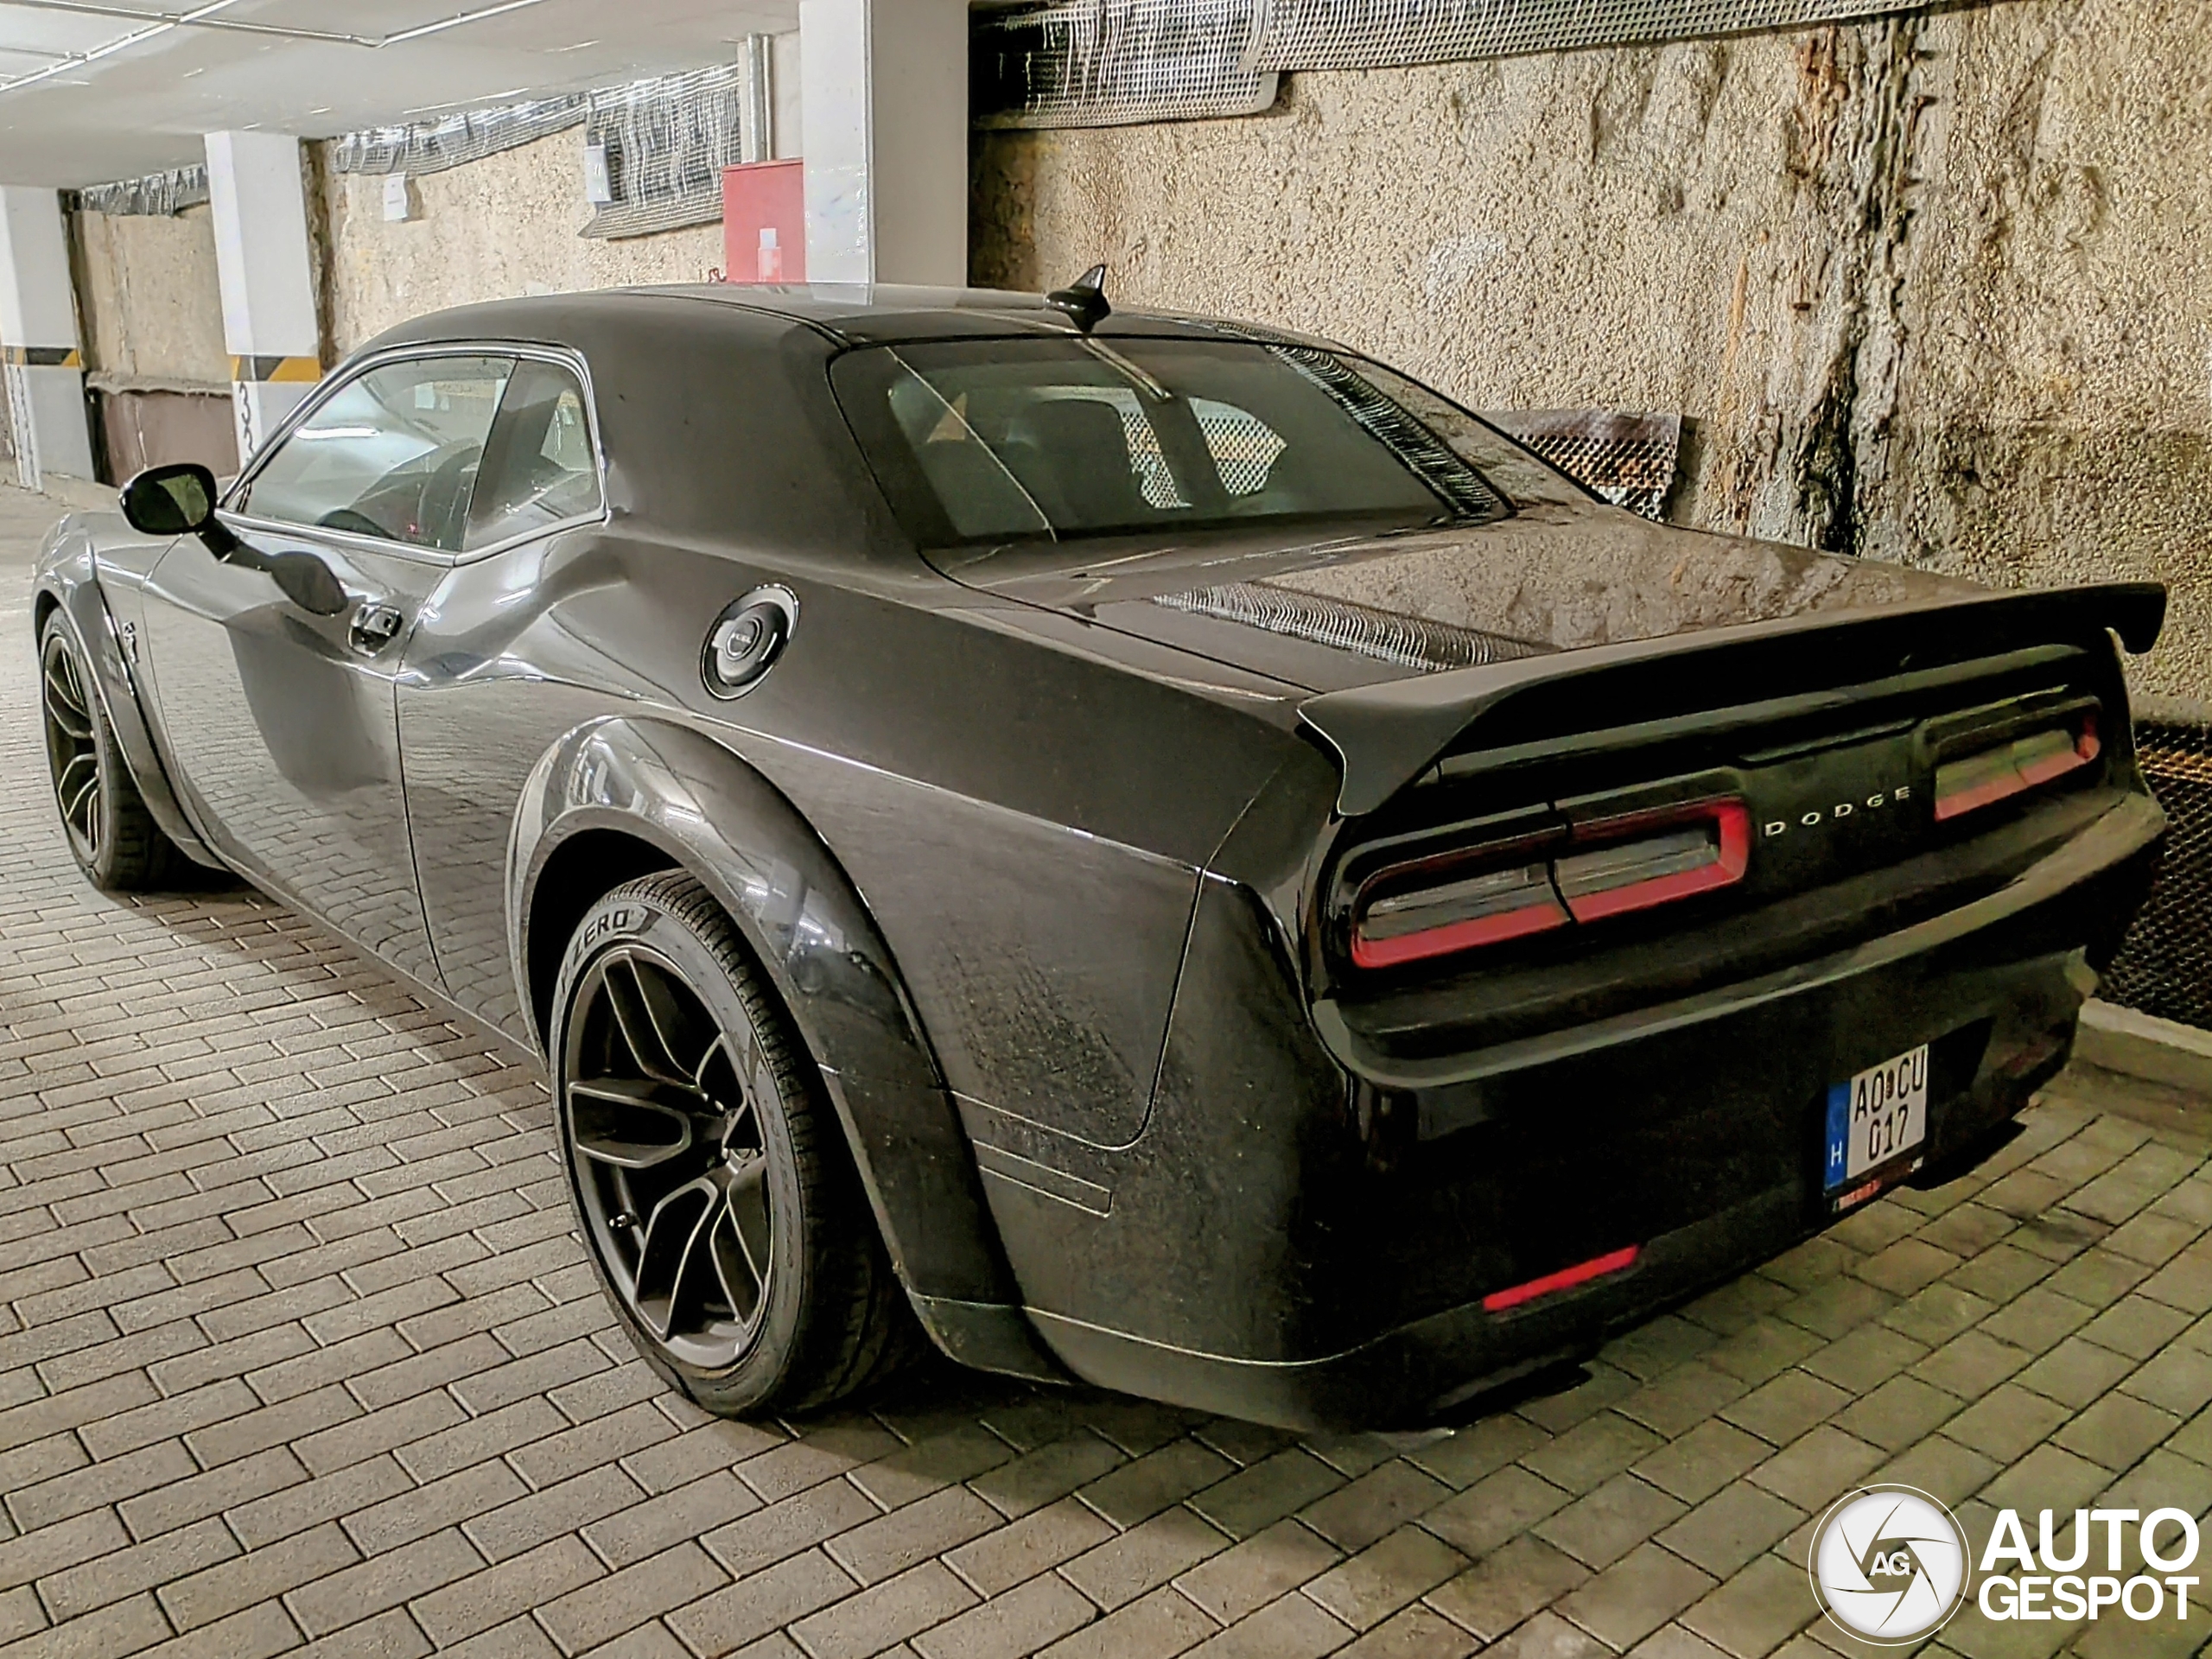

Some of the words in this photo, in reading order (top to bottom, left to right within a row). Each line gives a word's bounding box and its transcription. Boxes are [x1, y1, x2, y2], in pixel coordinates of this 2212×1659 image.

[1764, 785, 1910, 836] DODGE
[573, 909, 630, 967] ZERO
[1855, 1070, 1885, 1122] AO
[1897, 1048, 1925, 1100] CU
[1831, 1141, 1842, 1167] H
[1868, 1104, 1909, 1160] 017
